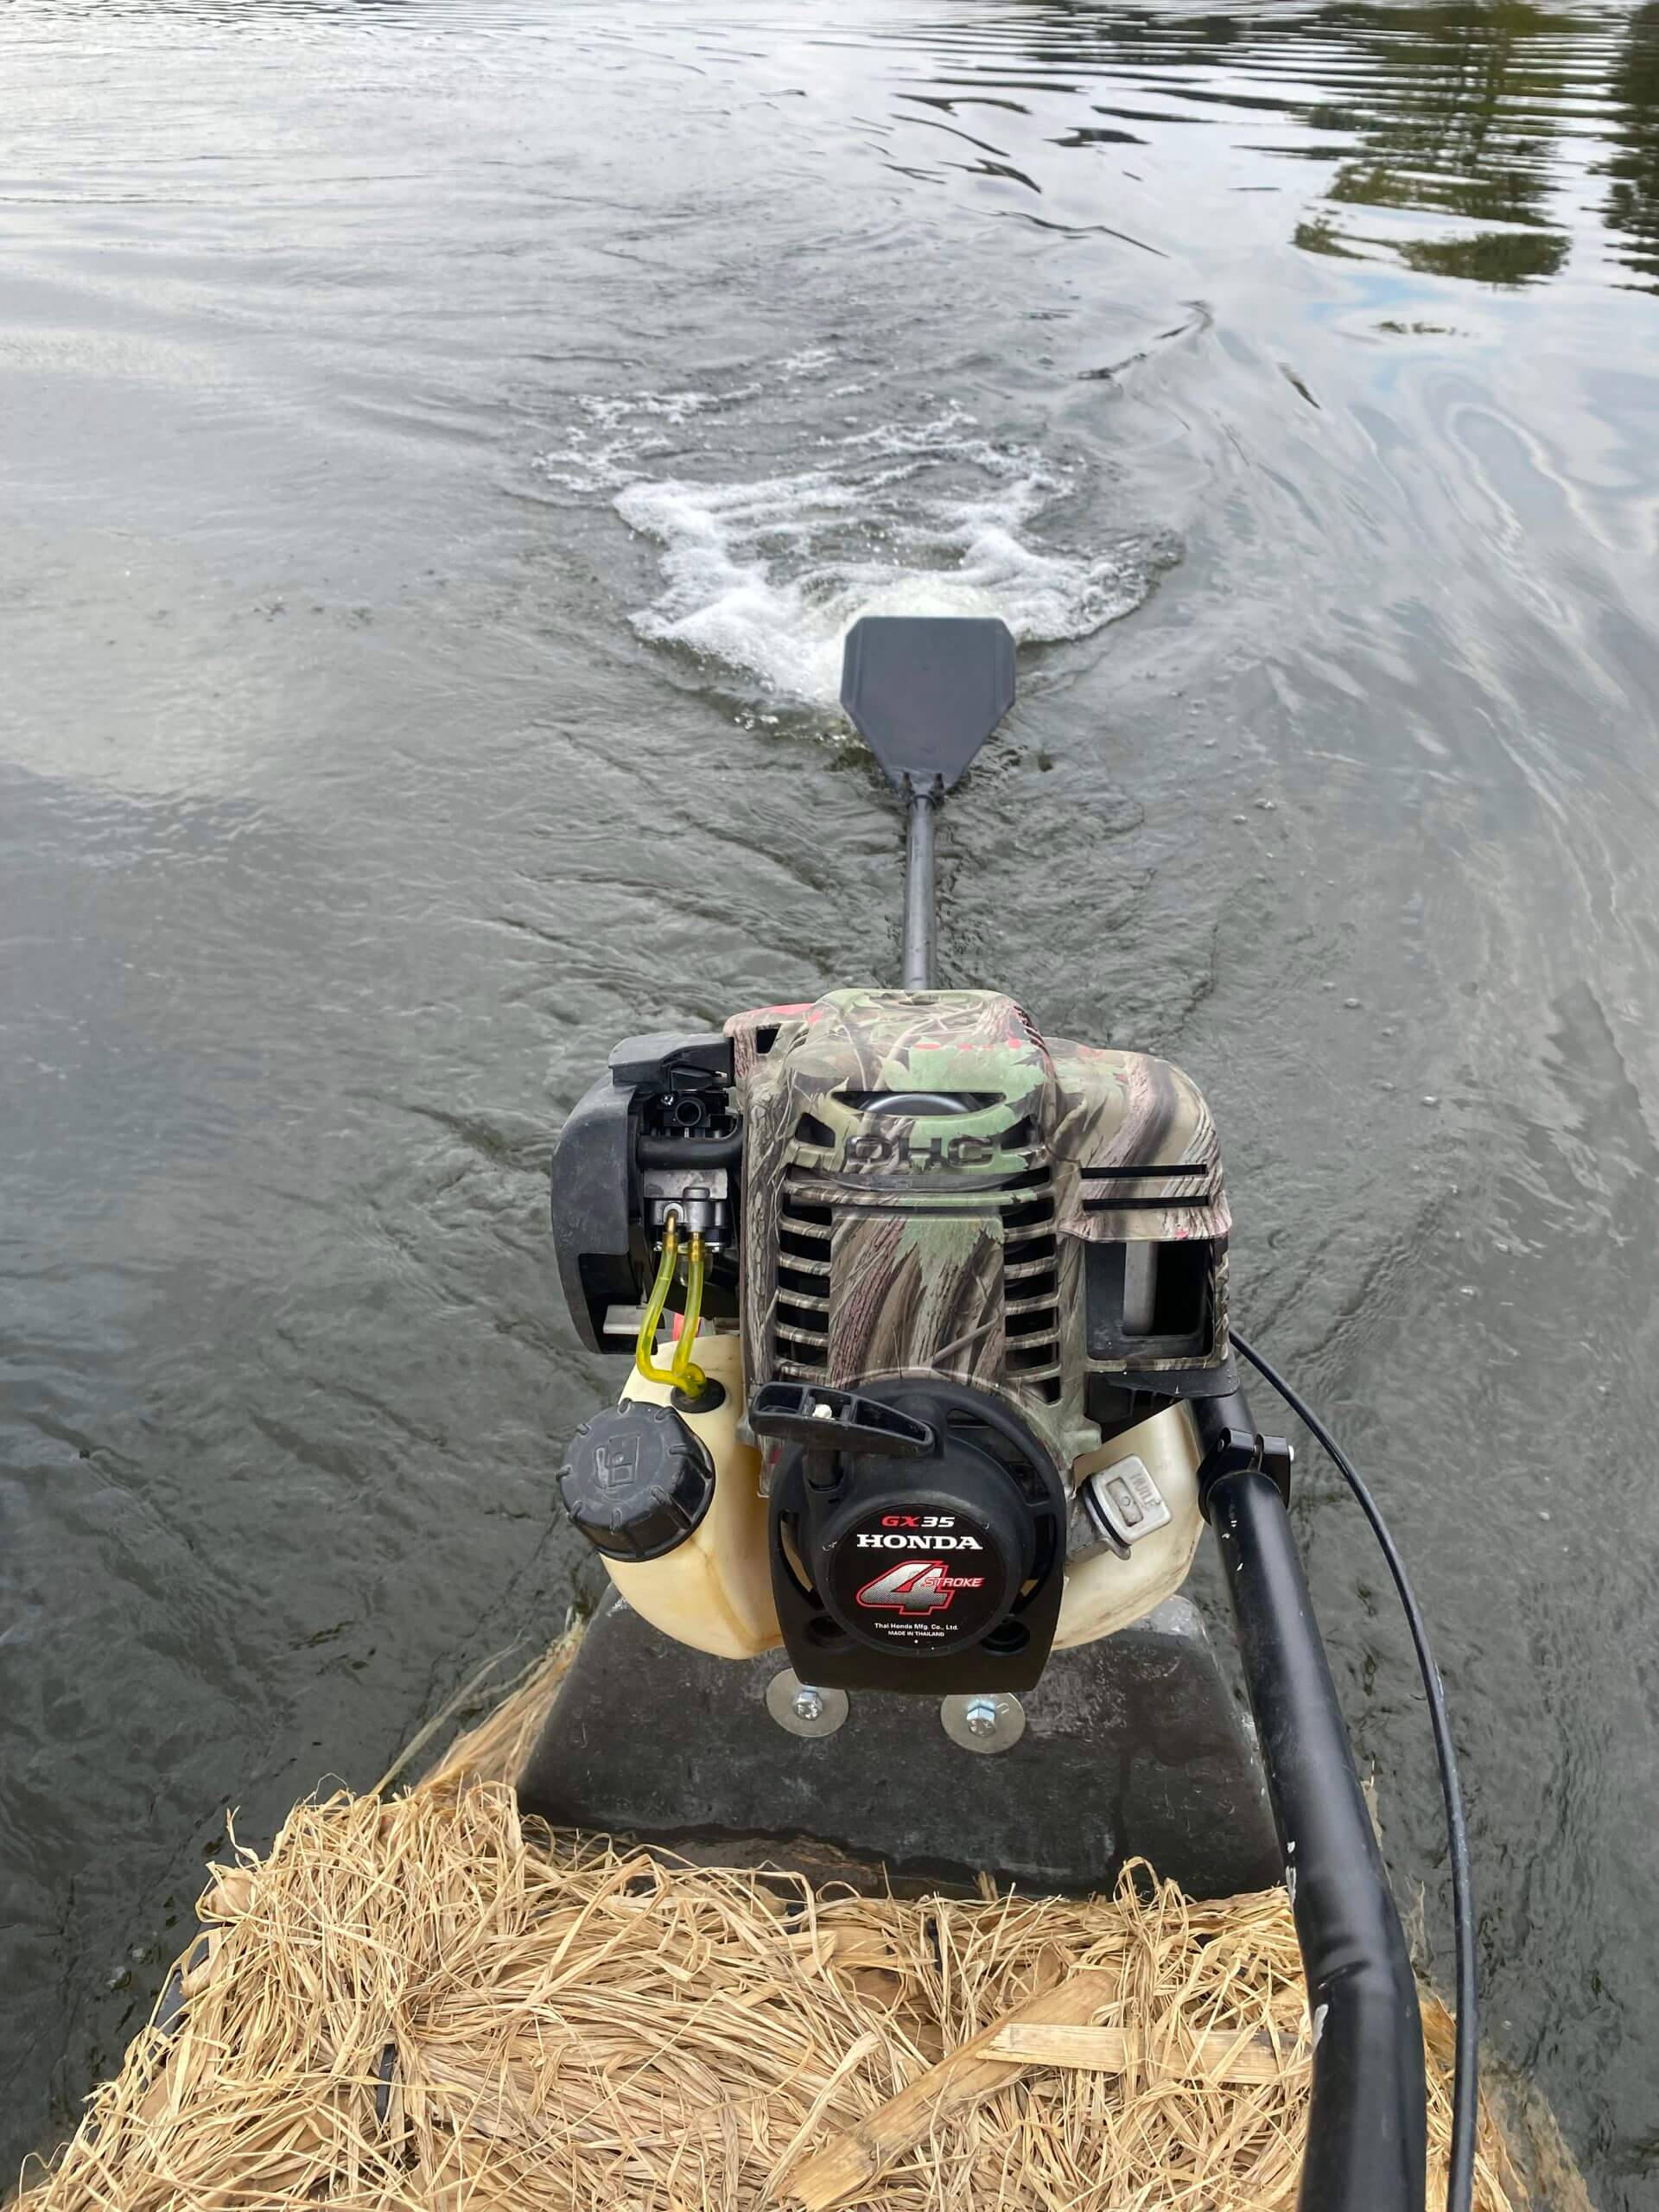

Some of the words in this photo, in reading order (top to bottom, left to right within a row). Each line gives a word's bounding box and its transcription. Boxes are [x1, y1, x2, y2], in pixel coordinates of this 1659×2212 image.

[845, 1135, 995, 1166] OHC
[881, 1516, 956, 1528] GX35
[856, 1534, 983, 1550] HONDA
[856, 1560, 956, 1616] 4
[923, 1577, 985, 1588] STROKE
